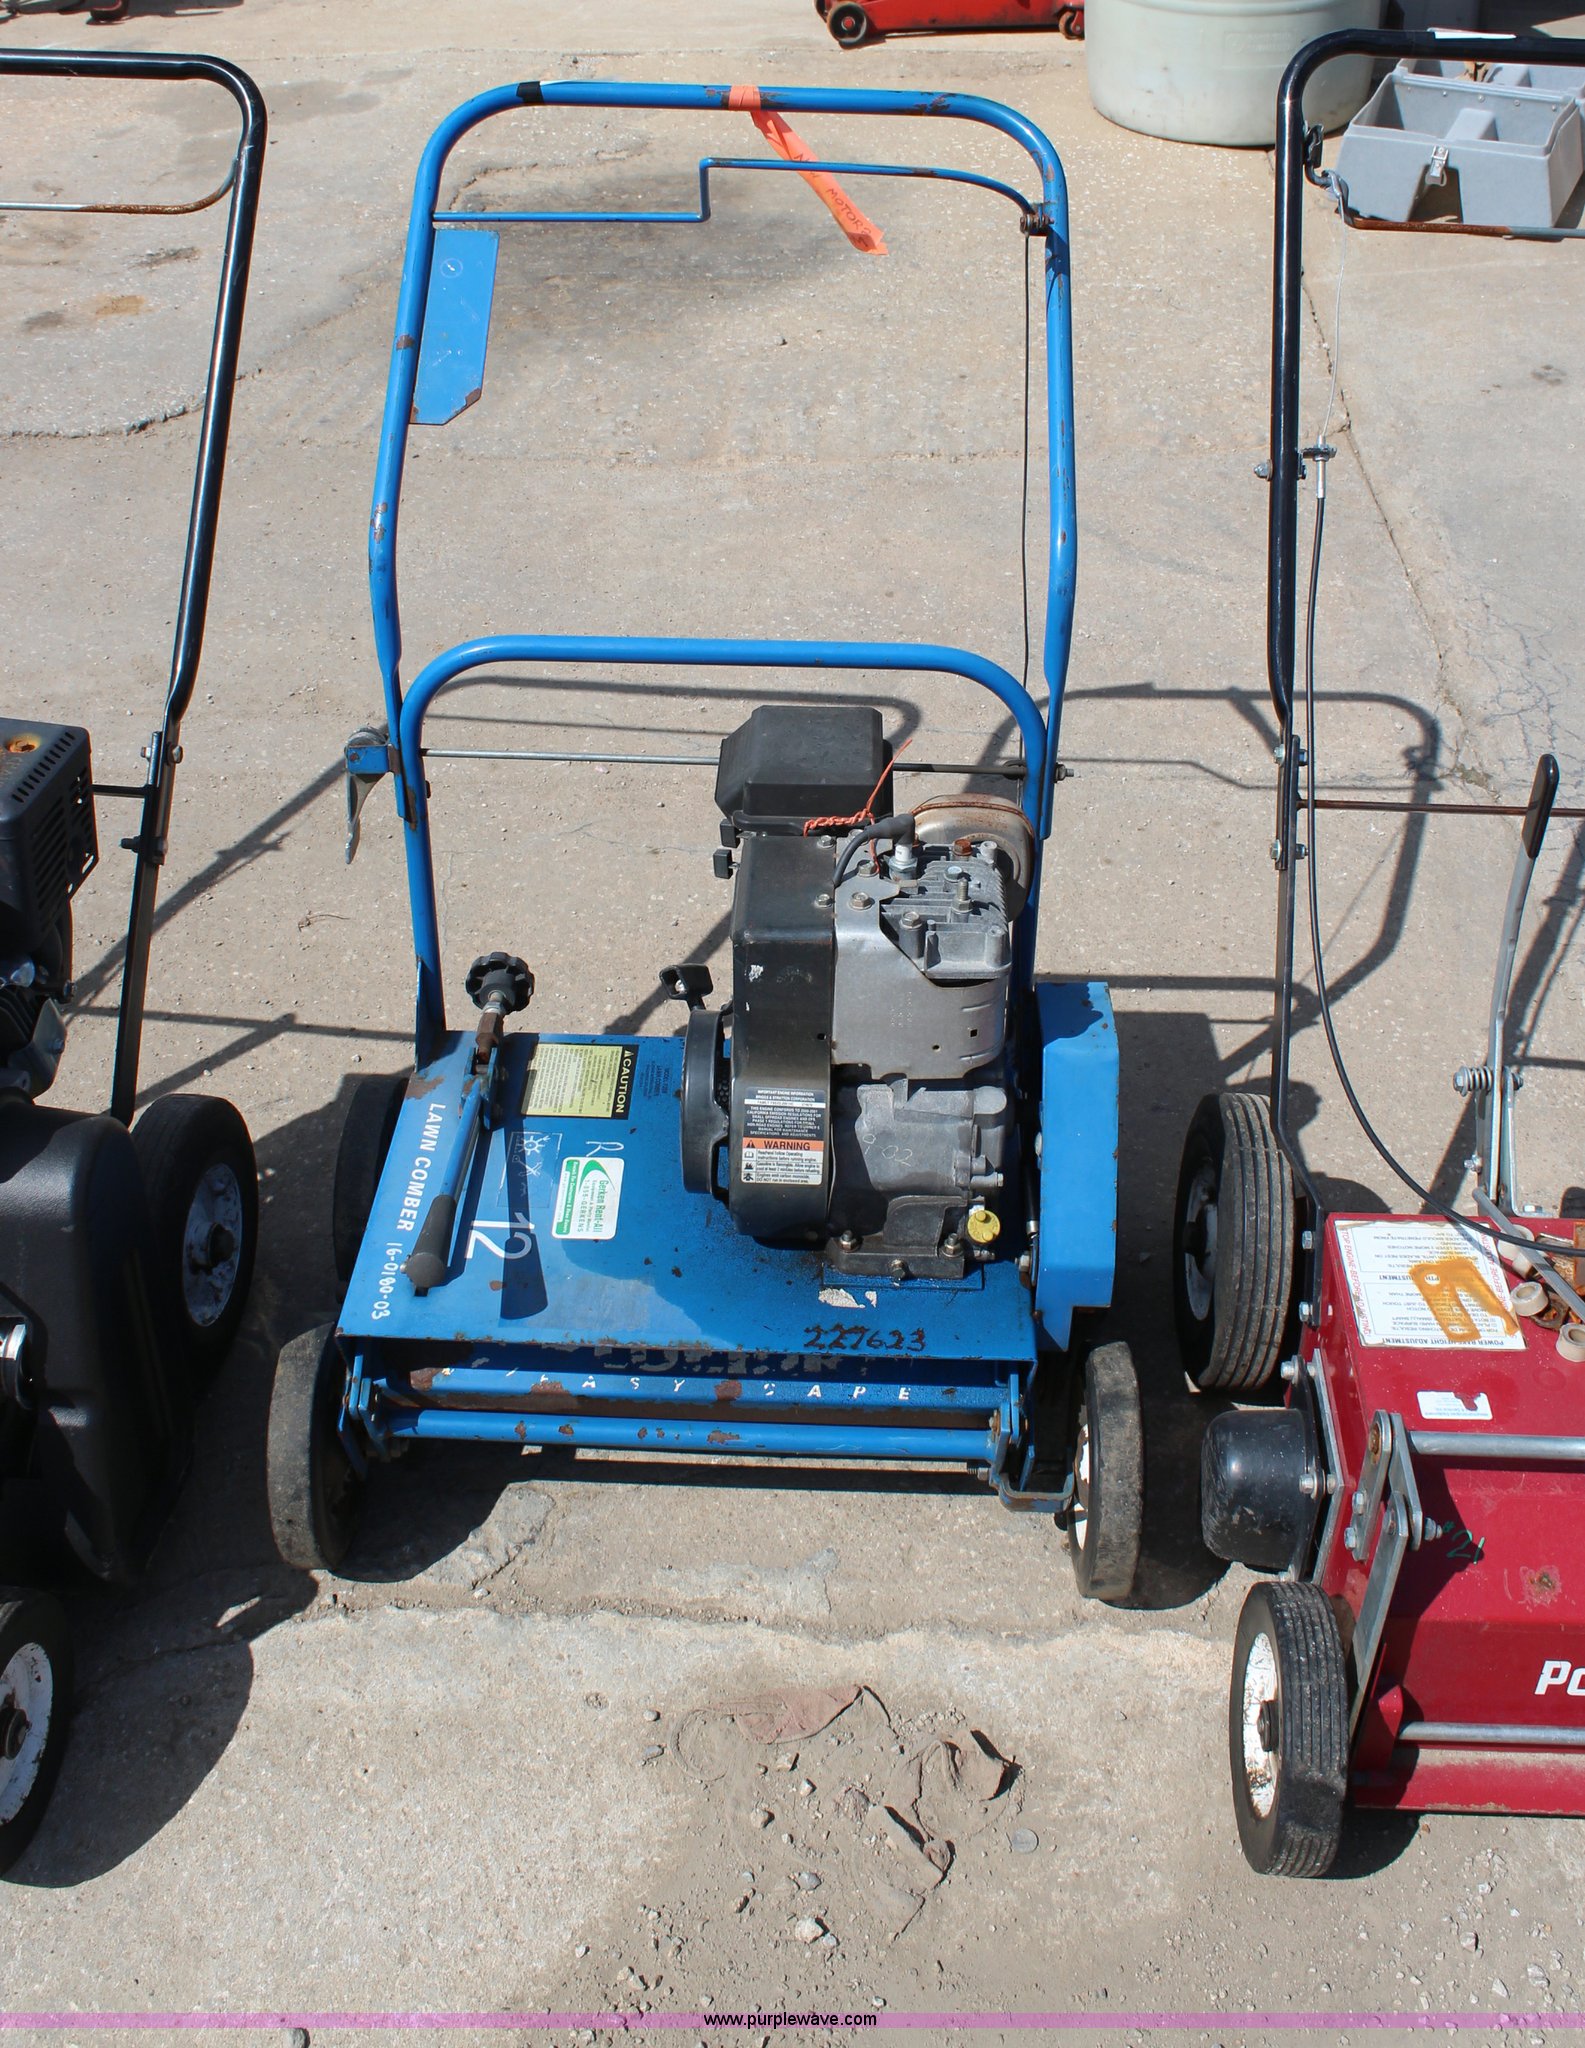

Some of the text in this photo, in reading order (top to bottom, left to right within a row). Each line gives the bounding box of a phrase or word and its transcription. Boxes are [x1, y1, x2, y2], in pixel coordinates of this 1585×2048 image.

[615, 1058, 632, 1113] CAUTION
[419, 1103, 446, 1151] LAWN
[764, 1141, 810, 1150] WARNING
[396, 1157, 431, 1231] COMBER
[593, 1180, 609, 1232] Gerken Rent-All
[463, 1212, 537, 1261] 12
[803, 1323, 926, 1351] 227623
